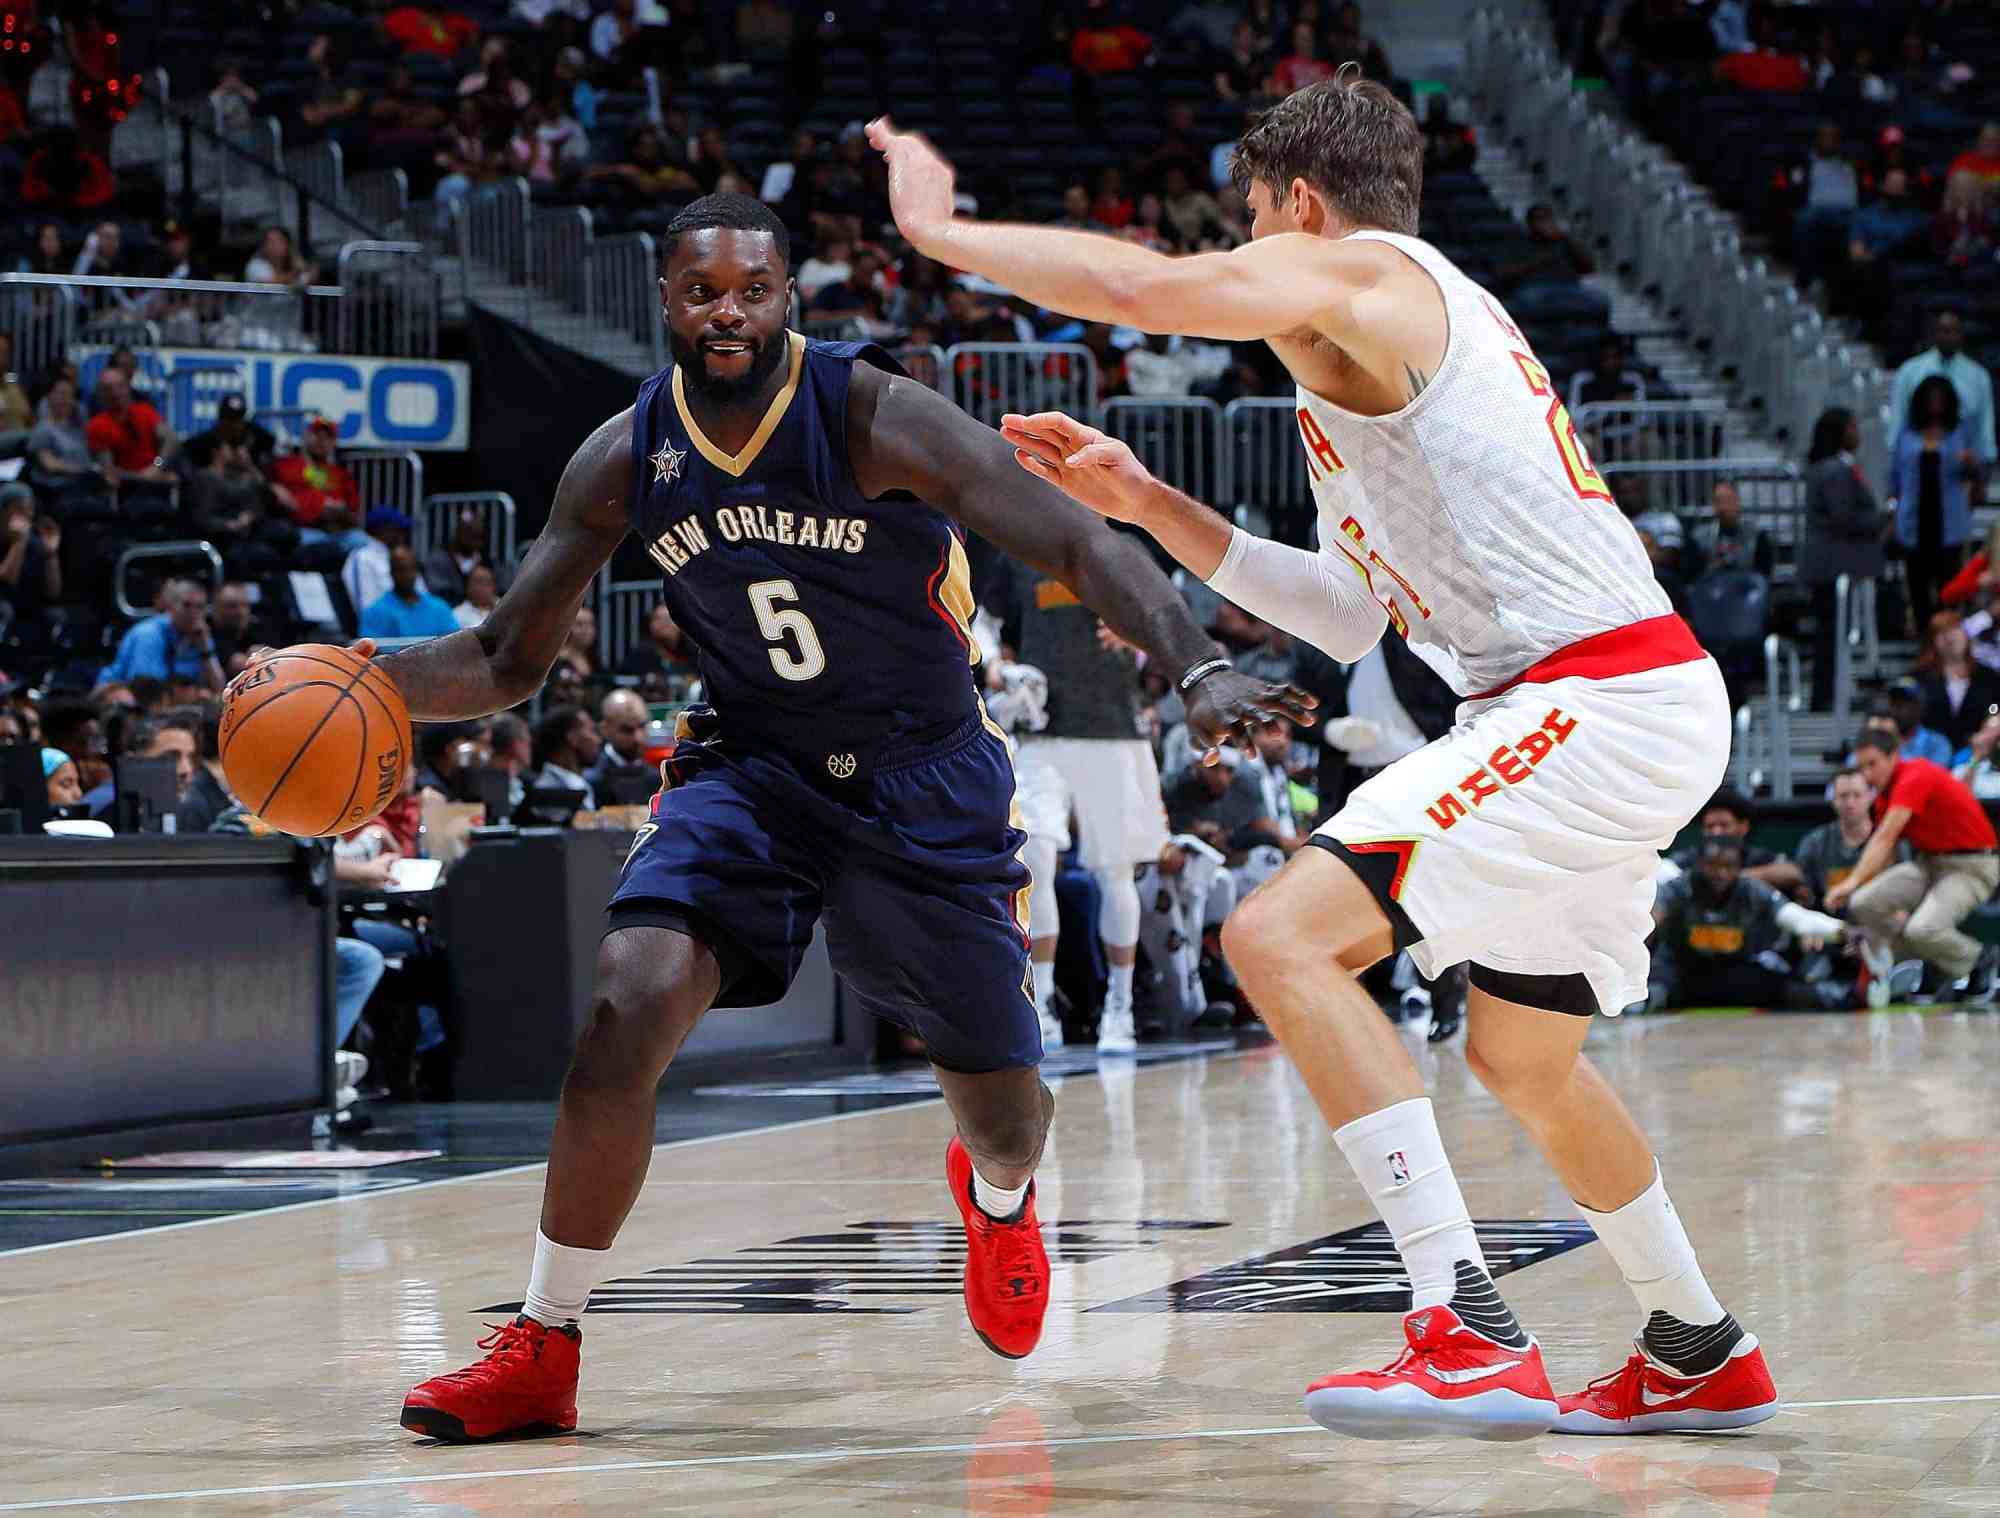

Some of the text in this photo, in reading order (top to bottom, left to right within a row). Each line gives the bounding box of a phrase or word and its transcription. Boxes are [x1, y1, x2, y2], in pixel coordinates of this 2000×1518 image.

[649, 505, 867, 575] NEW ORLEANS
[748, 579, 825, 681] 5
[1425, 707, 1579, 831] HAWKS
